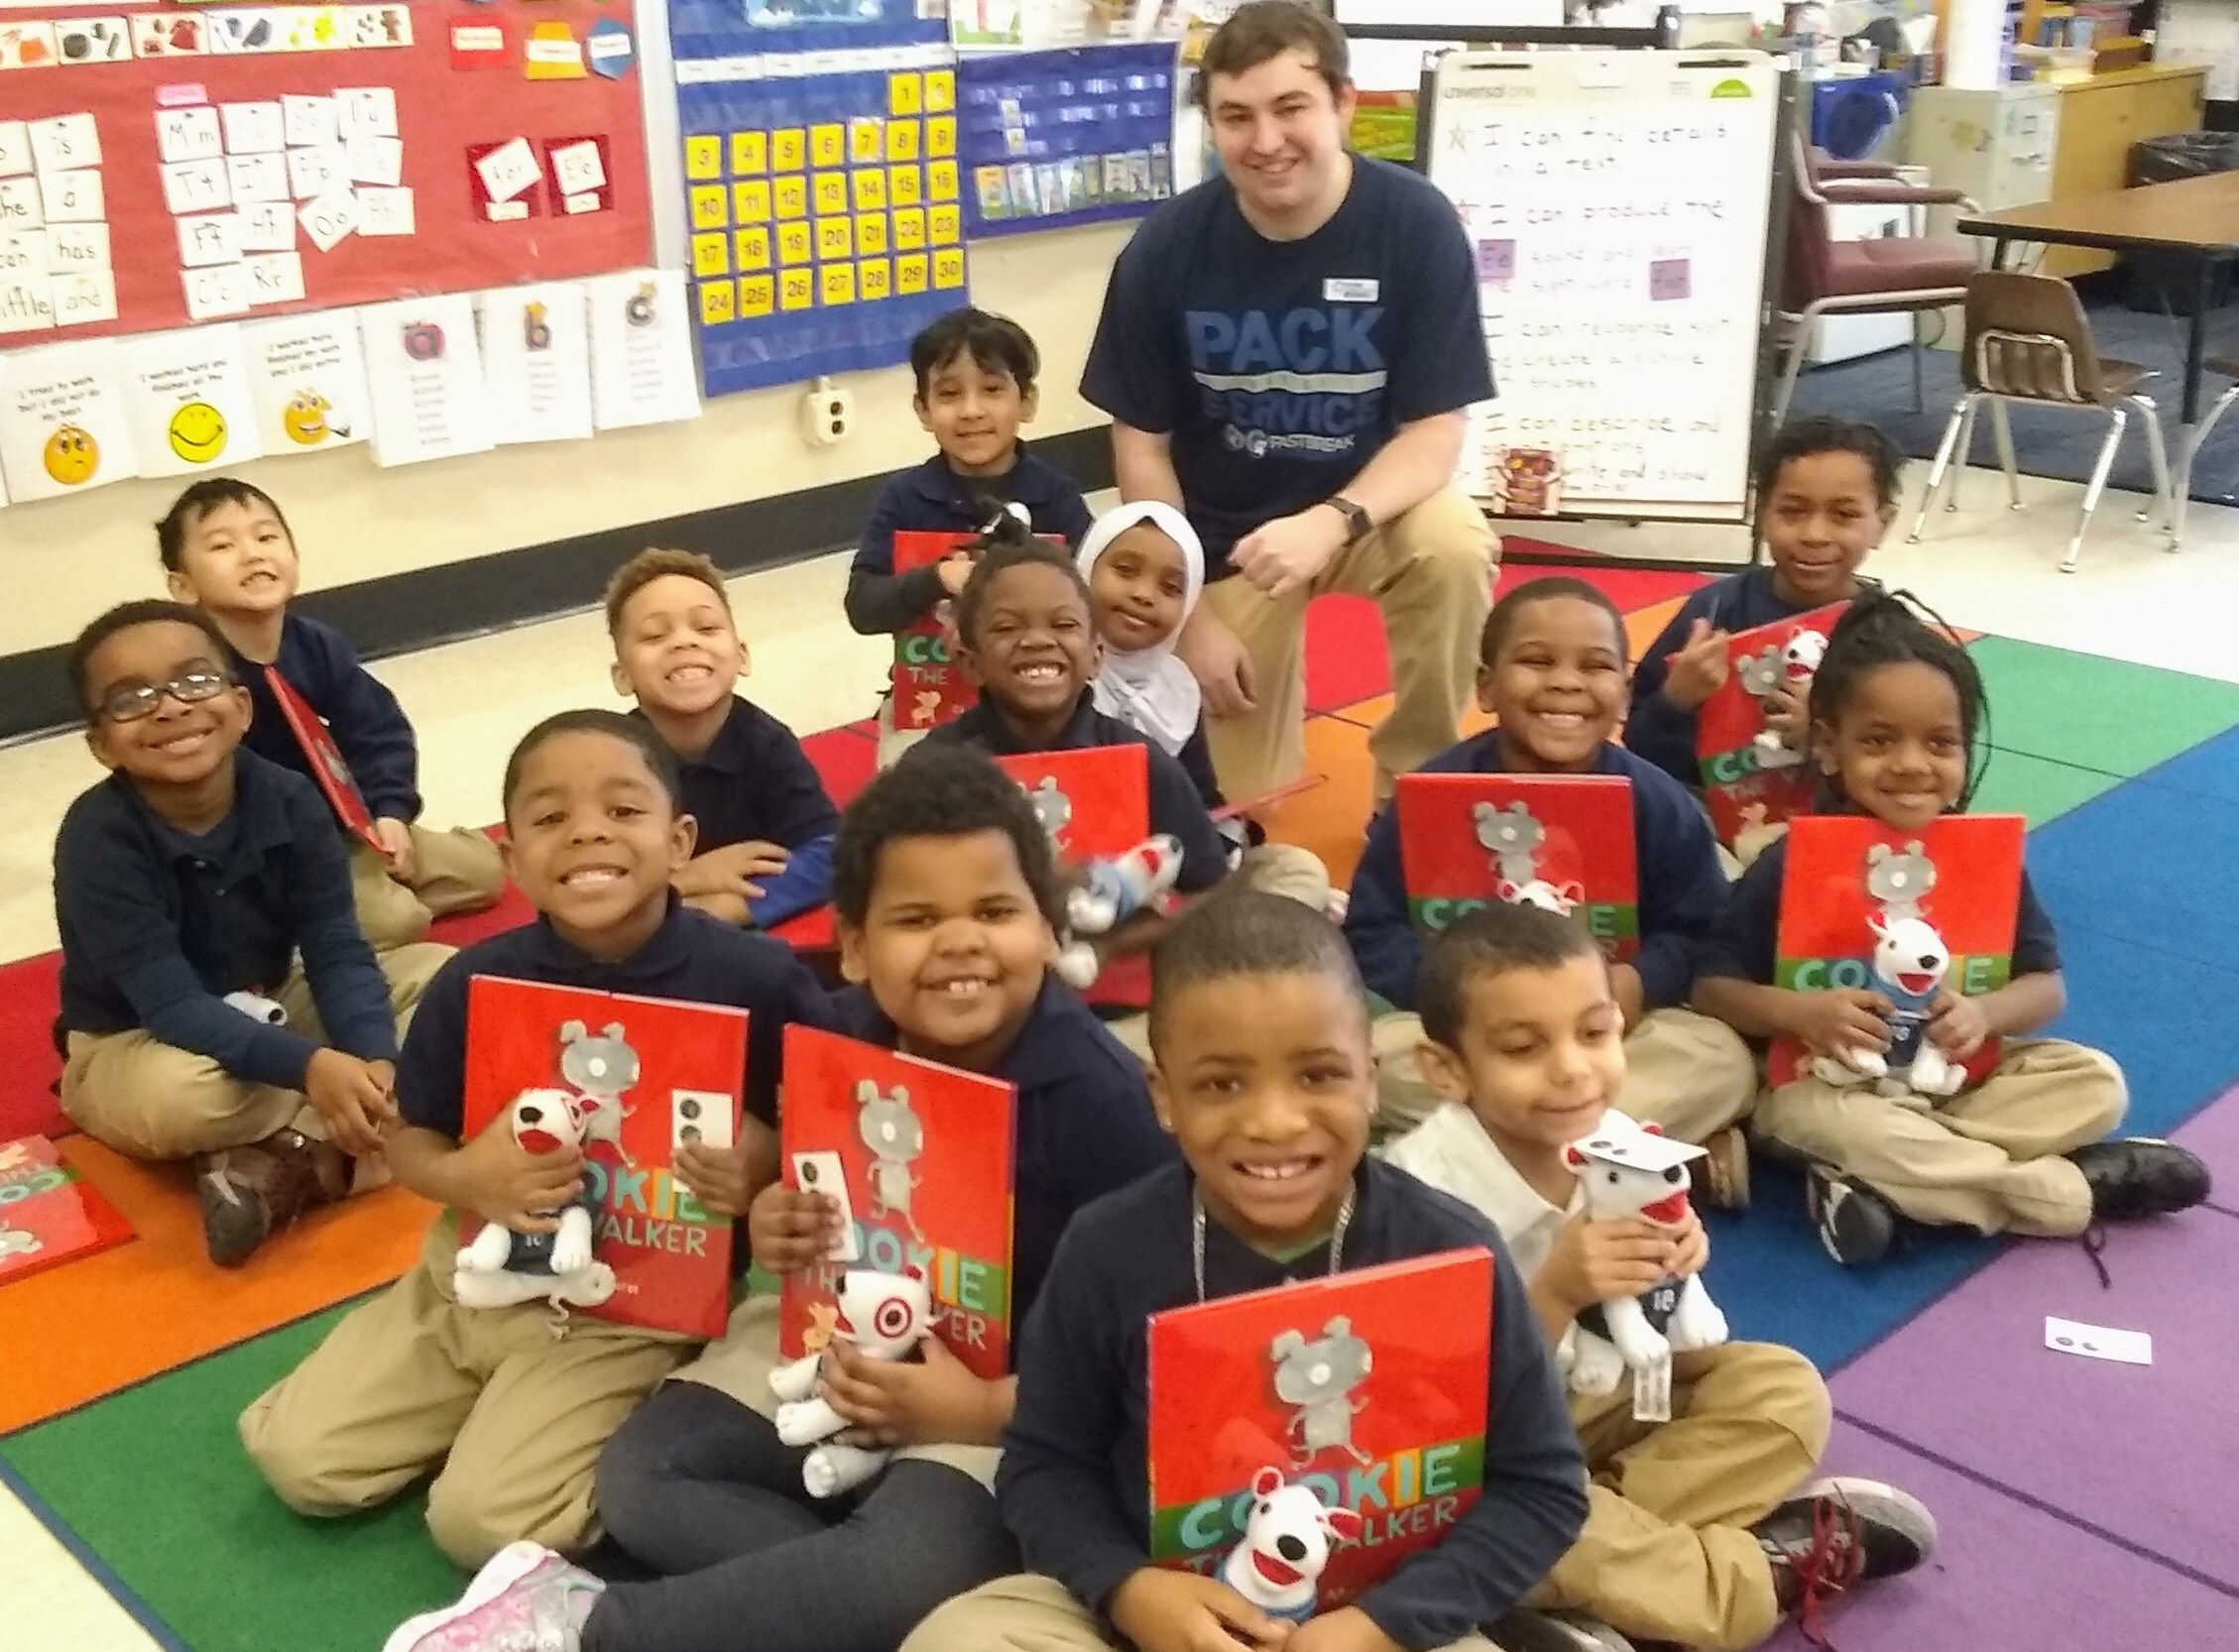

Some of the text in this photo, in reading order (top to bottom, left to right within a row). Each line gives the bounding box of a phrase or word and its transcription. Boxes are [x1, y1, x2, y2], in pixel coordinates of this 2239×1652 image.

[699, 149, 709, 166] 3
[743, 143, 754, 159] 4
[783, 142, 793, 159] 5
[823, 138, 834, 154] 6
[861, 134, 872, 151] 7
[936, 131, 948, 147] 9
[0, 193, 29, 217] he
[700, 172, 952, 216] 10 11 12 13 14 15 16
[700, 216, 955, 263] 17 18 19 20 21 22 23
[0, 290, 52, 318] ittle
[707, 261, 960, 312] 24 25 26 27 28 29 30
[1185, 307, 1386, 372] PACK
